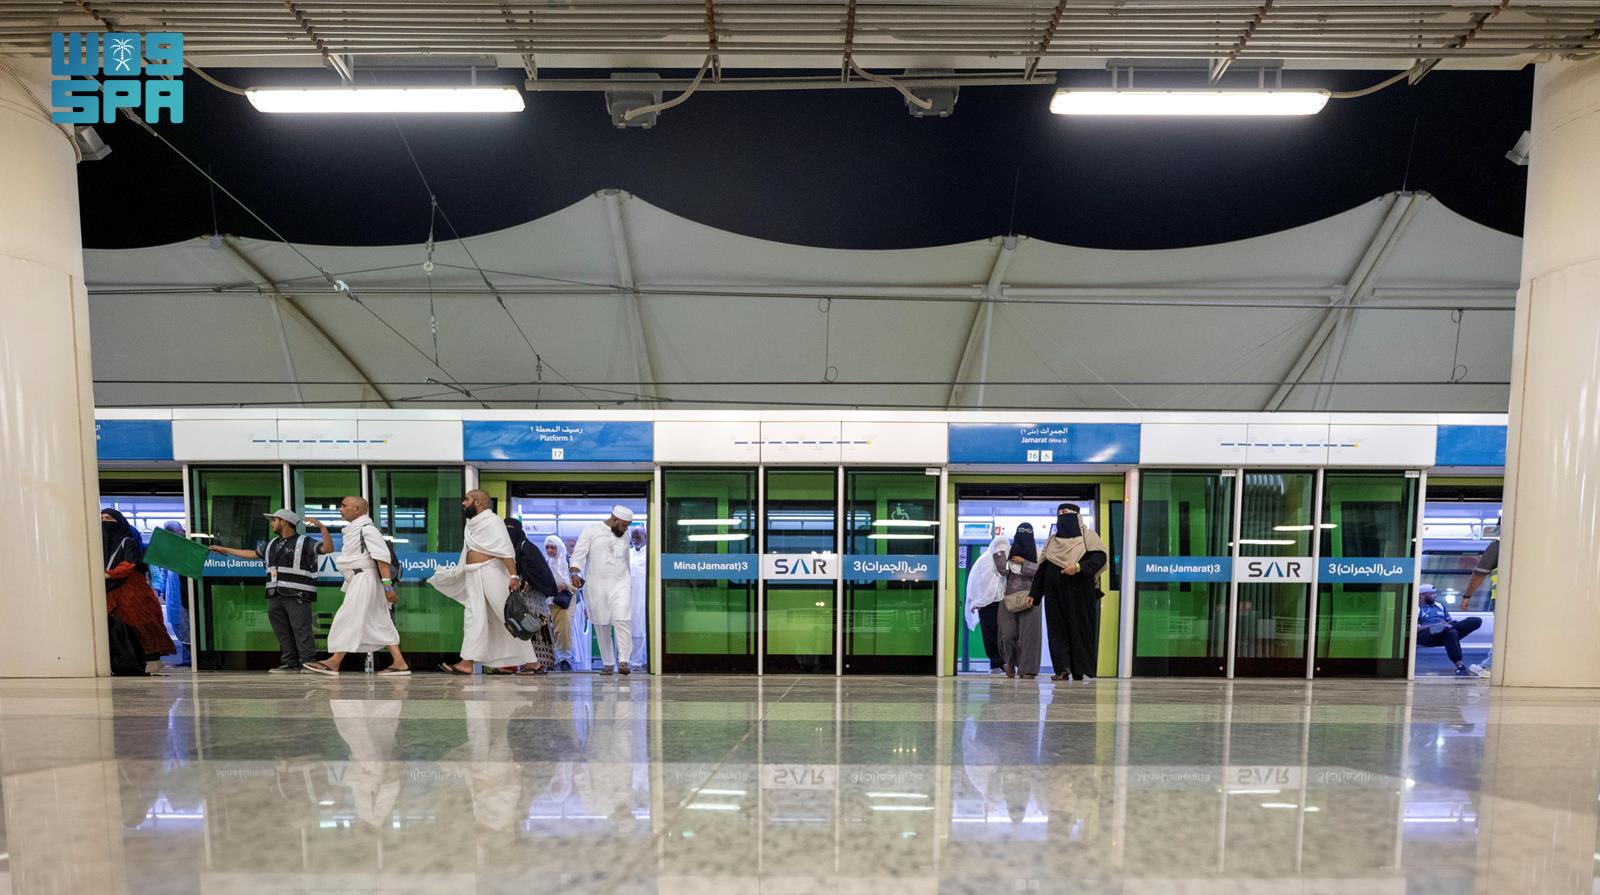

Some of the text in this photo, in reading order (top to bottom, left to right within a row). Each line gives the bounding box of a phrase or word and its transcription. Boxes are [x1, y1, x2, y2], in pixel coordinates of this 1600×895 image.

[535, 425, 561, 433] المحطة
[561, 426, 583, 434] رصيف
[1040, 427, 1068, 436] الجمرات
[540, 434, 569, 442] Platform
[774, 559, 827, 574] SAR
[1248, 562, 1301, 577] SAR
